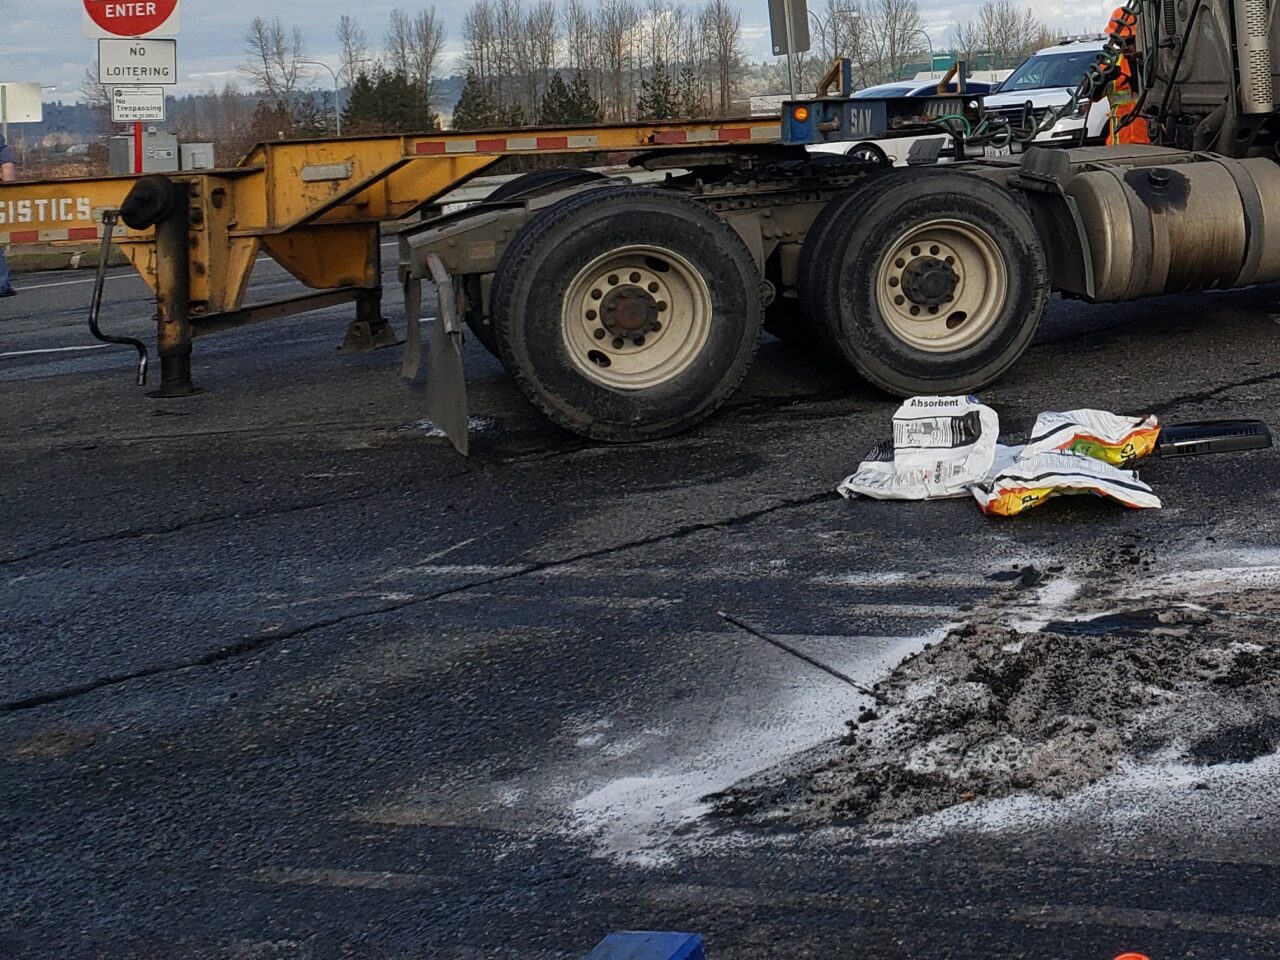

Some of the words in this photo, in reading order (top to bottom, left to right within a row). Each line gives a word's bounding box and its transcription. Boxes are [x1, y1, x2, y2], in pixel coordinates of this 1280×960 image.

[105, 2, 156, 18] ENTER
[129, 47, 146, 56] NO
[106, 66, 169, 76] LOITERING
[910, 399, 959, 407] Absorbent
